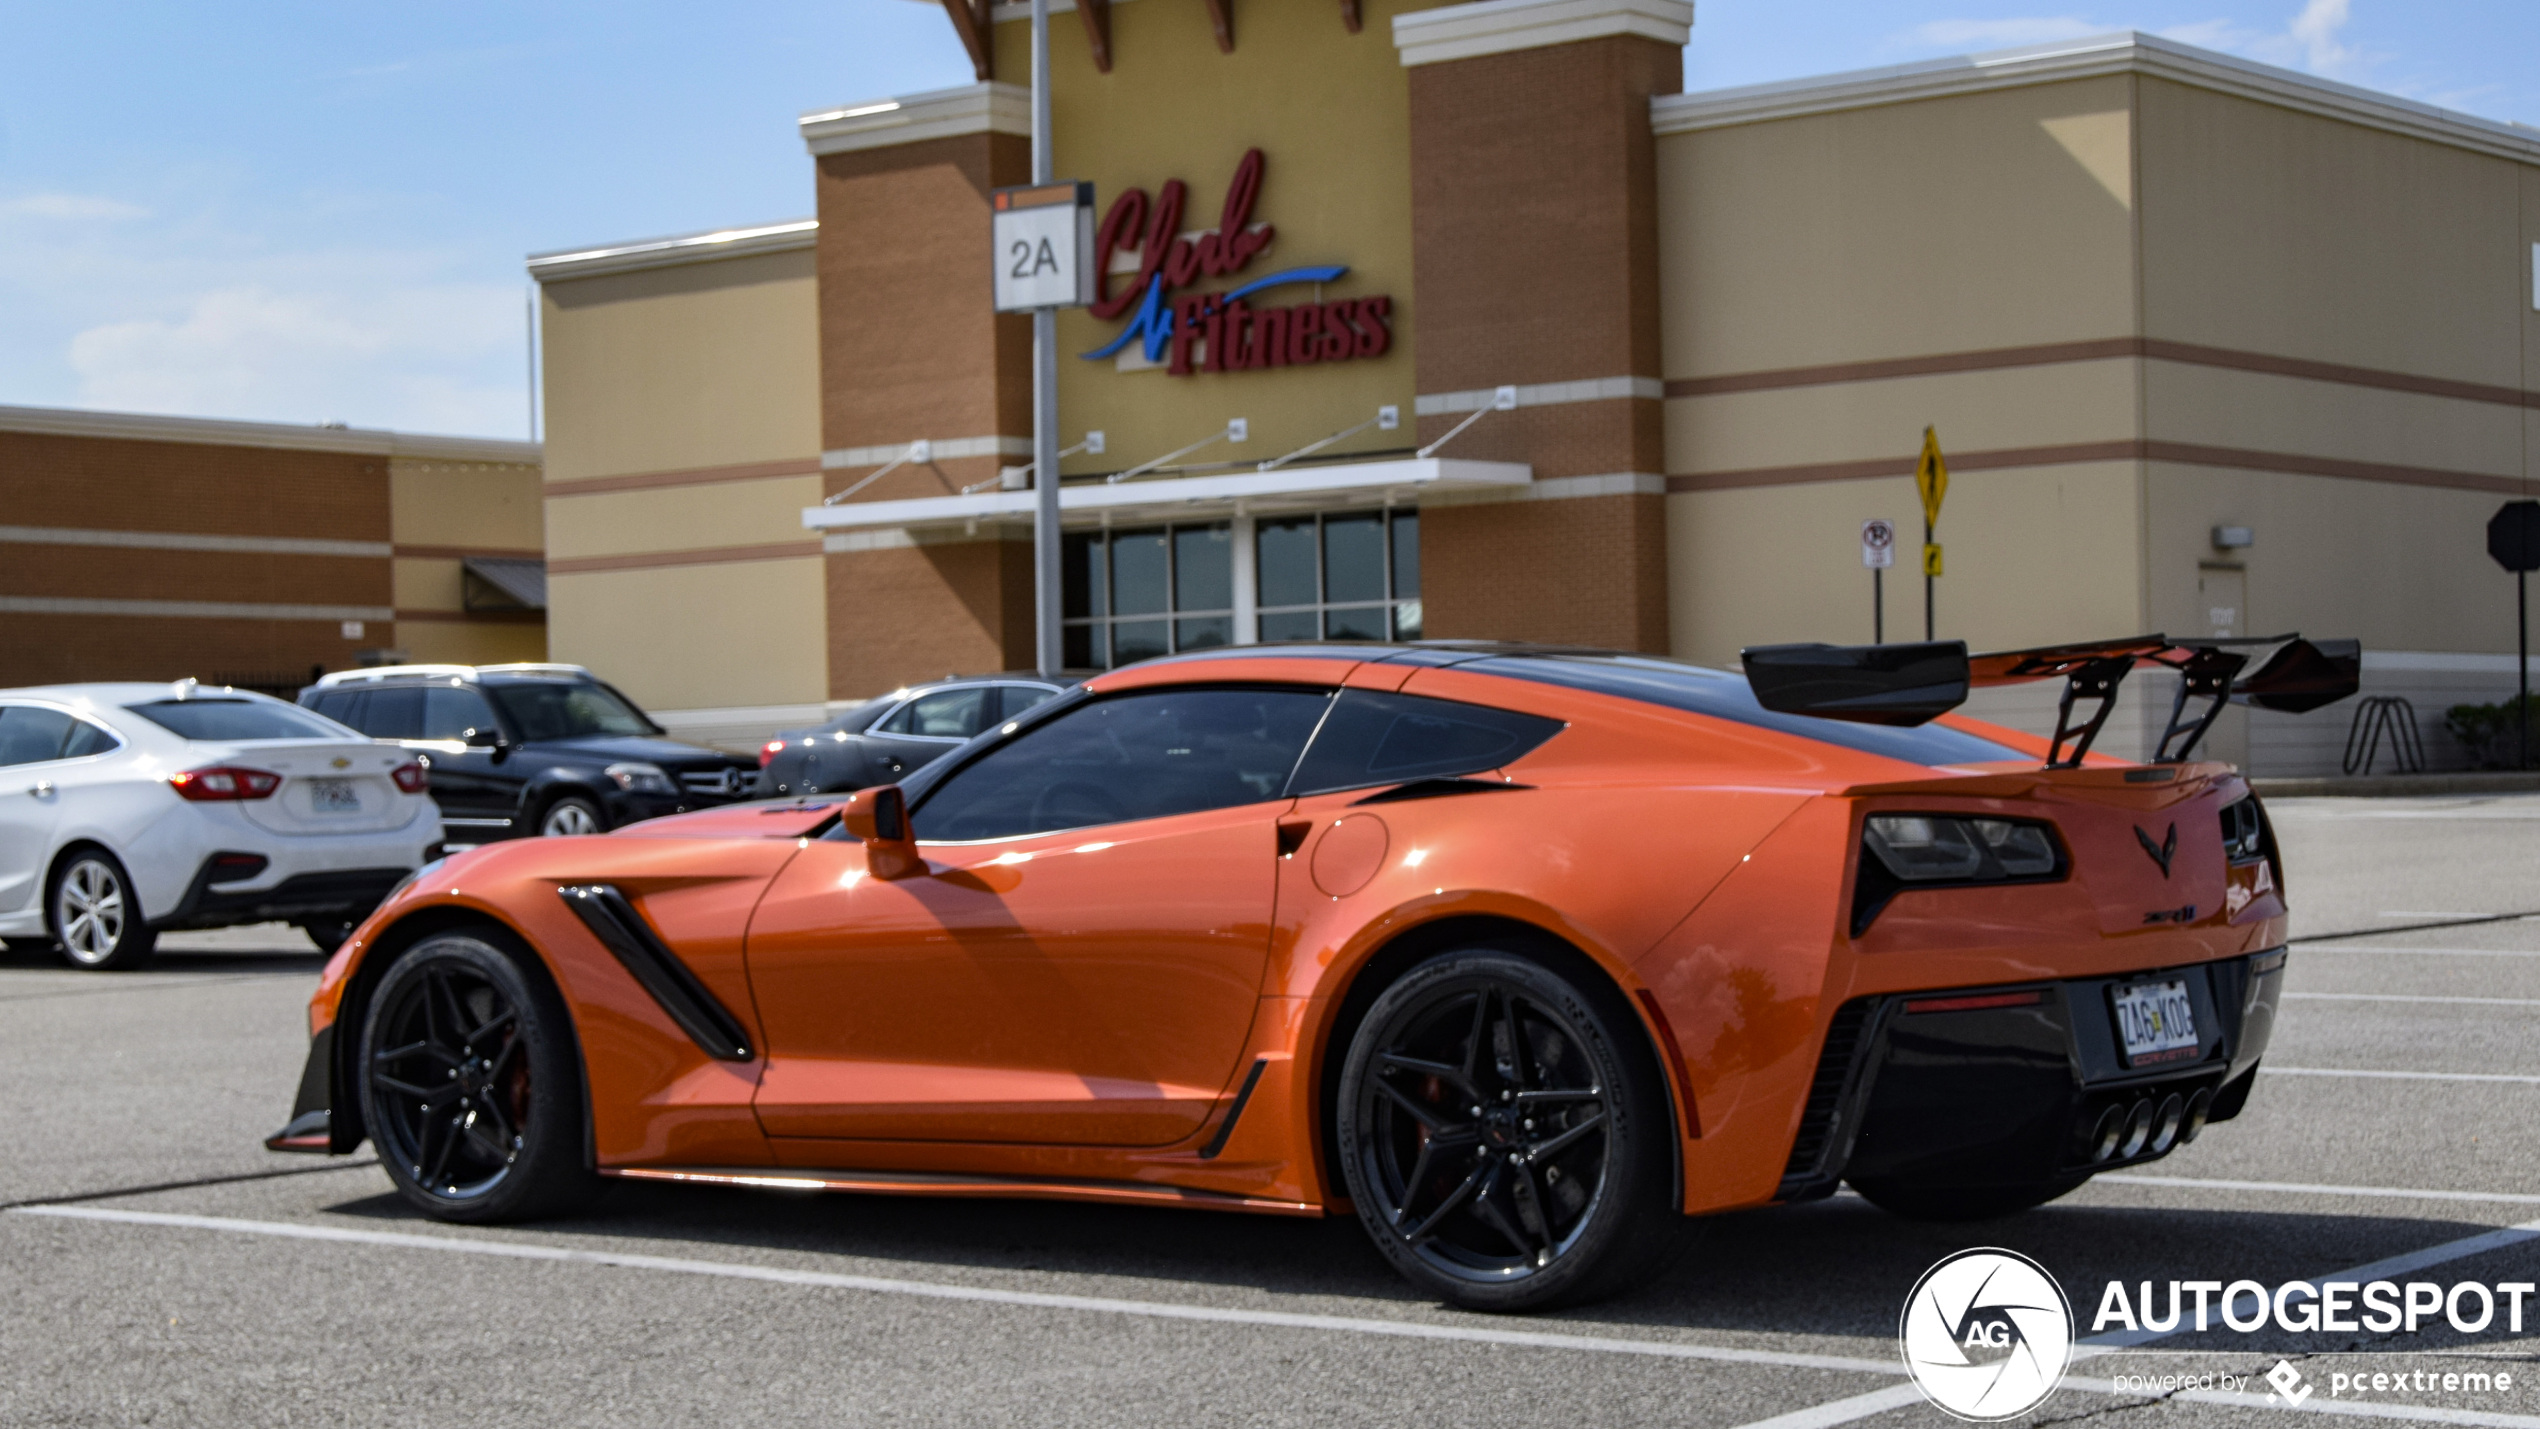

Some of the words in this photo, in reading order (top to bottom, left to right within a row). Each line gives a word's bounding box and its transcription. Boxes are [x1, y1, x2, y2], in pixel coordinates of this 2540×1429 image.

[1010, 236, 1059, 279] 2A
[1088, 147, 1275, 320] Club
[1167, 292, 1394, 378] Fitness
